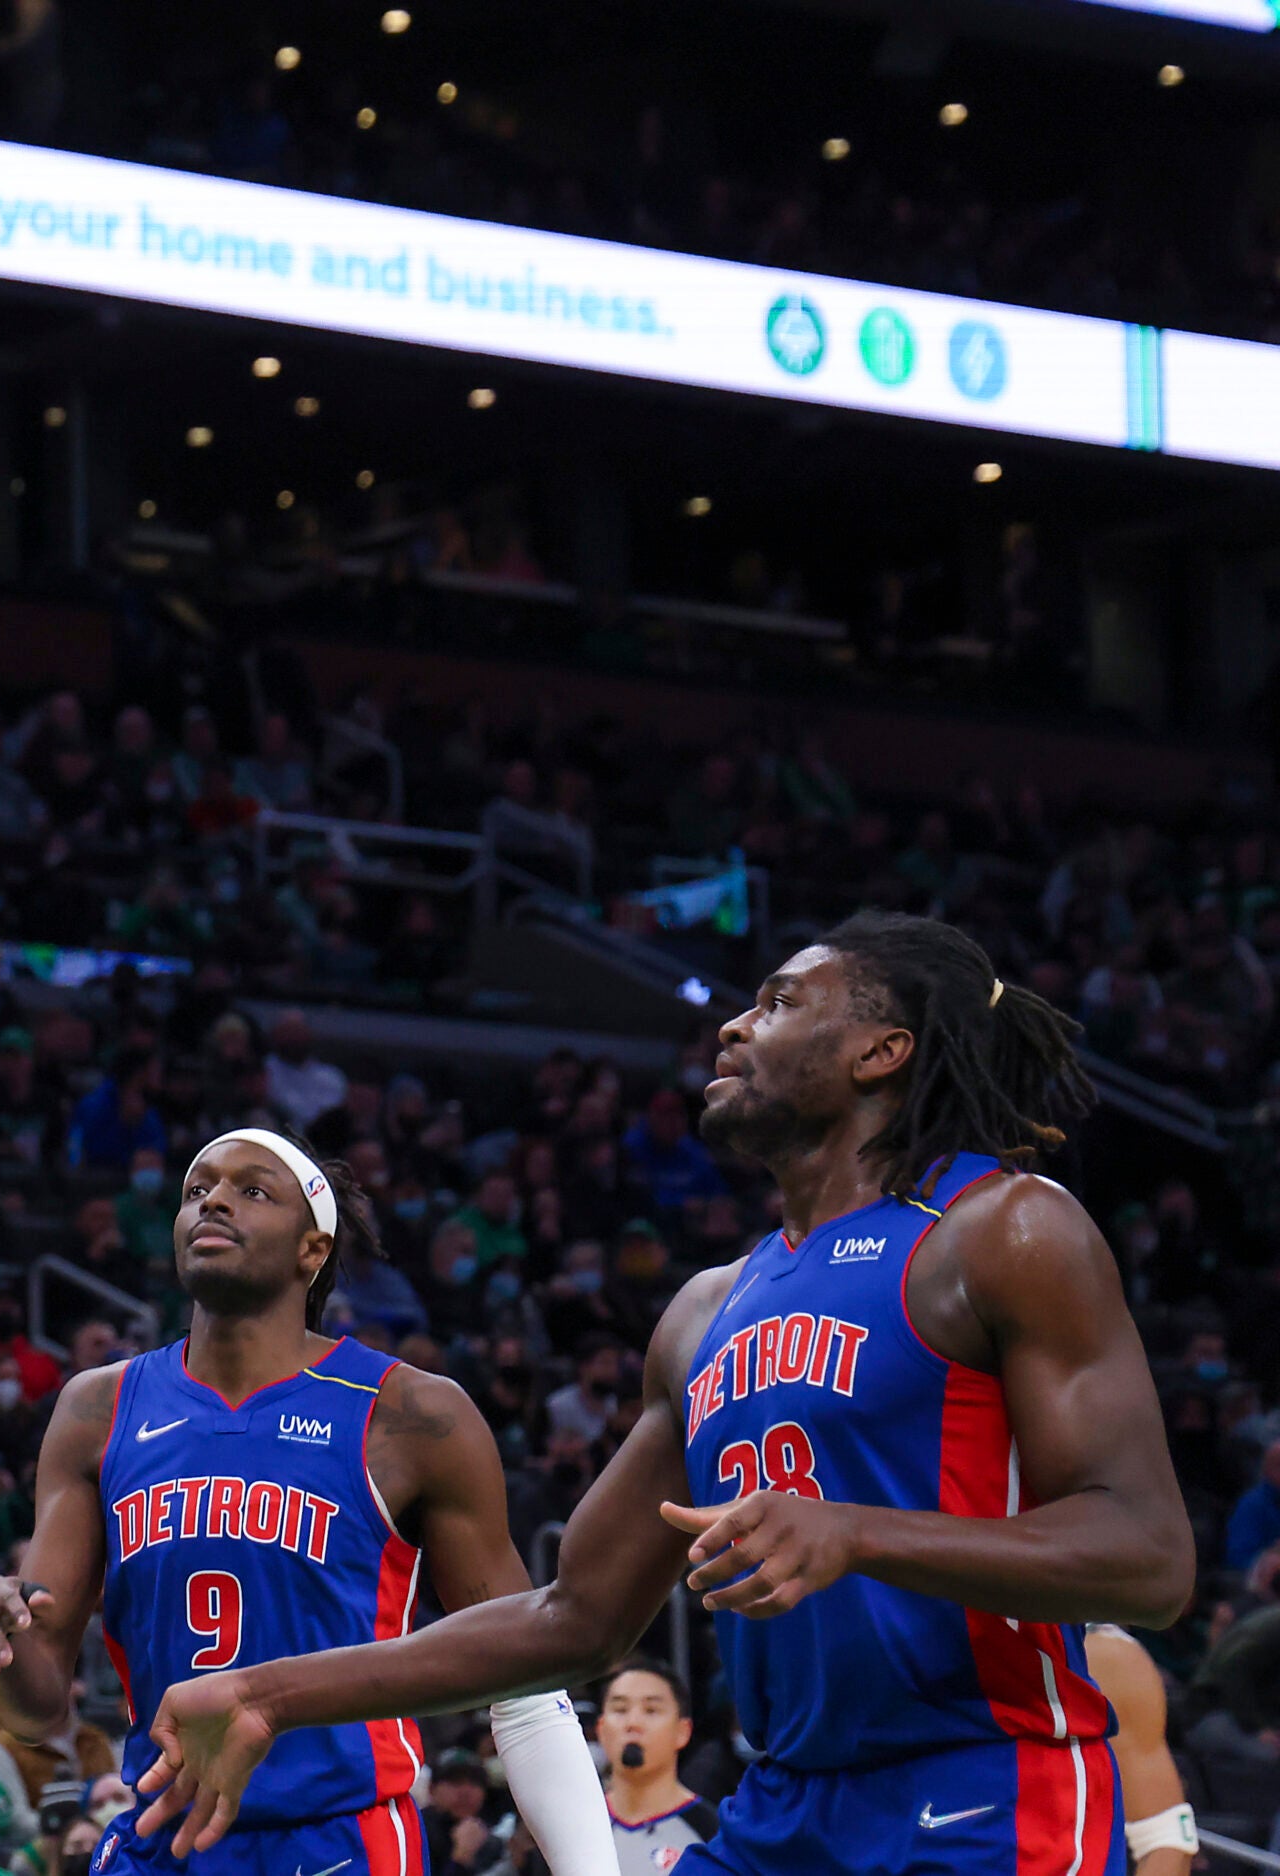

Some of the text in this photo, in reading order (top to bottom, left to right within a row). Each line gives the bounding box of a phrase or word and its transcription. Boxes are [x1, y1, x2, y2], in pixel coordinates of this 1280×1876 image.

[138, 205, 293, 277] home
[310, 244, 409, 295] and
[425, 252, 675, 337] business.
[833, 1237, 887, 1258] UWM
[687, 1312, 869, 1448] DETROIT
[279, 1414, 332, 1439] UWM
[718, 1421, 825, 1501] 28
[112, 1476, 340, 1565] DETROIT
[186, 1570, 243, 1670] 9
